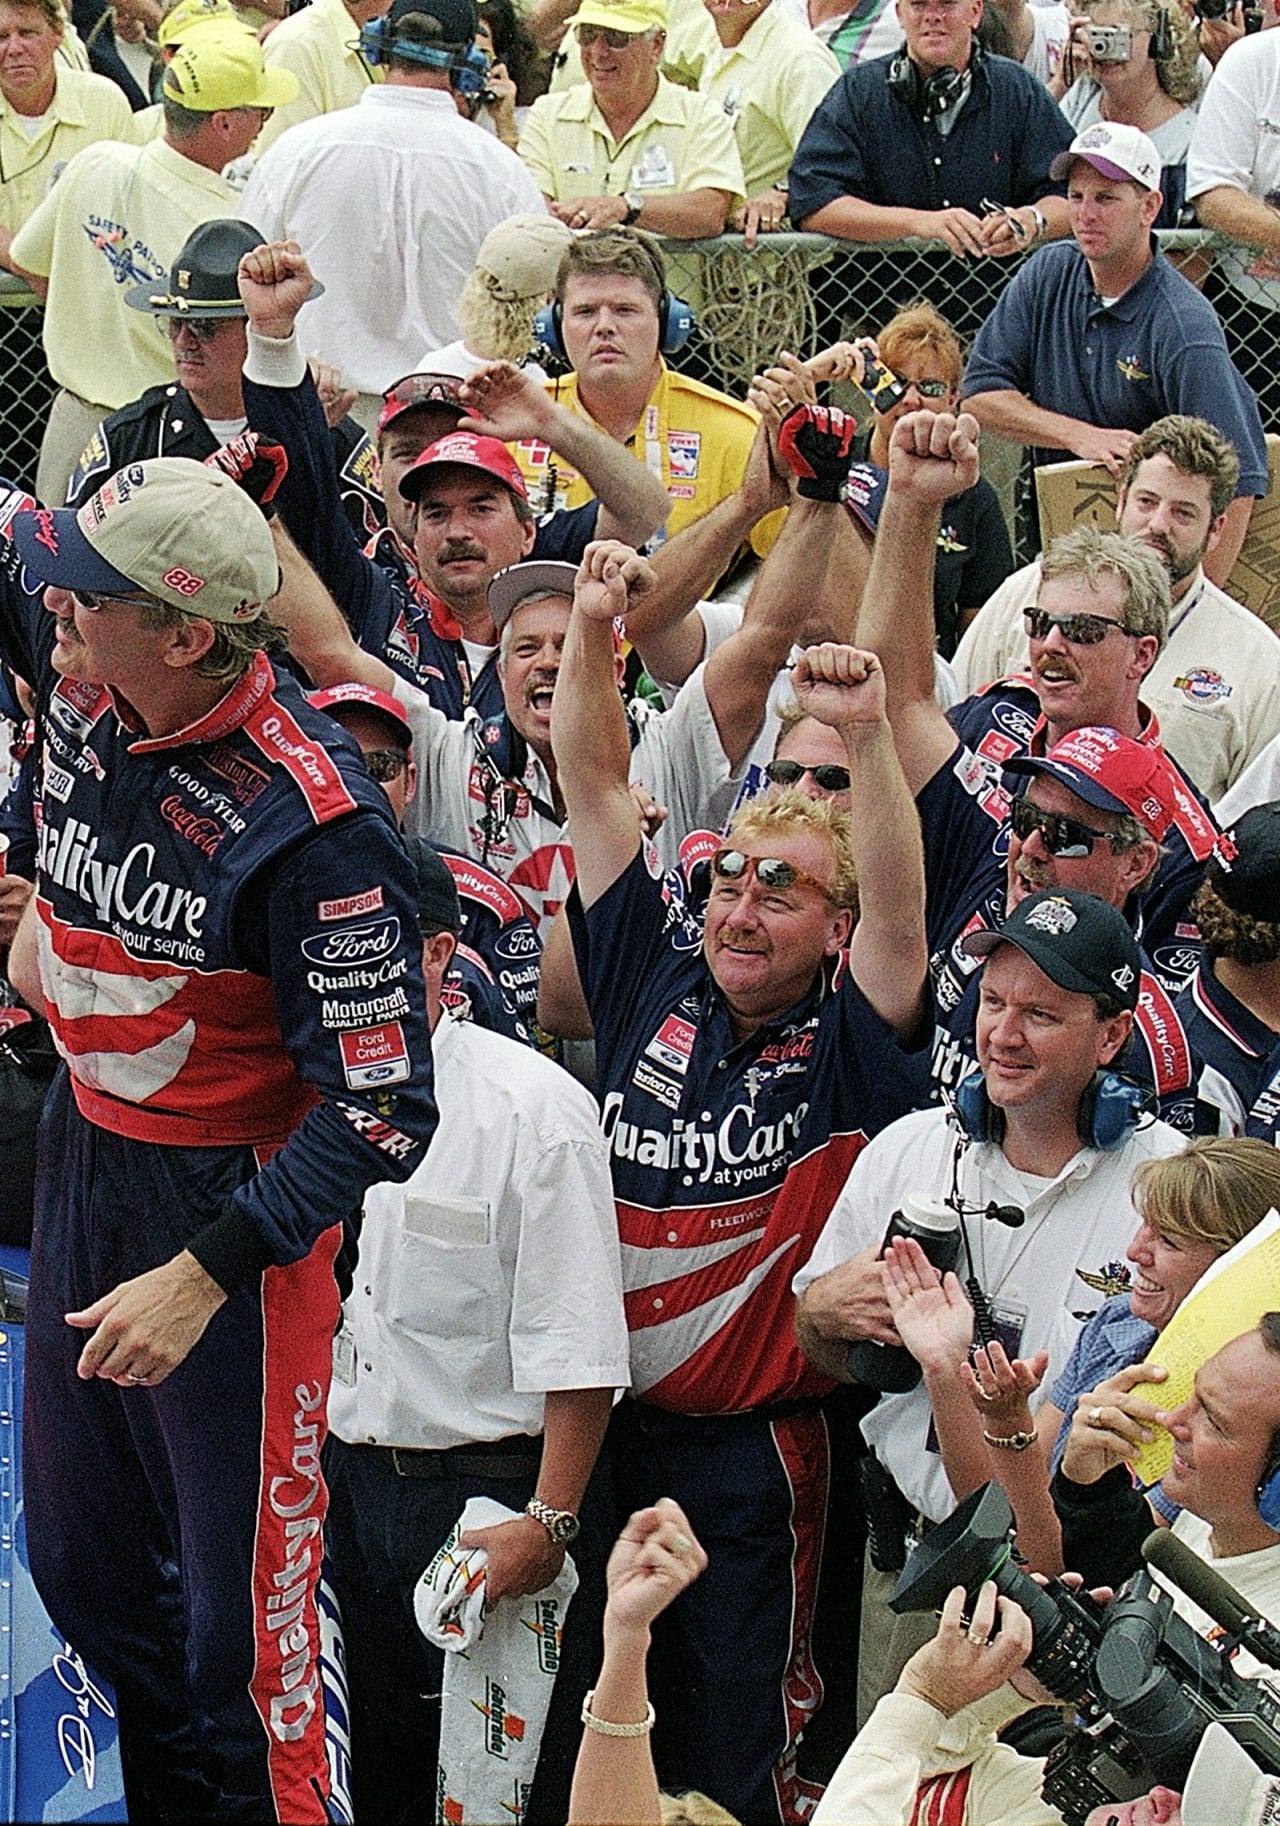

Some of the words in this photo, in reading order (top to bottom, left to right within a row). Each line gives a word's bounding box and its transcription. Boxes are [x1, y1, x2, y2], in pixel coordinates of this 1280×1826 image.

[88, 214, 128, 240] SAFETY
[132, 240, 168, 279] PATRO
[162, 565, 207, 598] 88
[169, 765, 247, 835] GOODYEAR
[1141, 797, 1163, 821] 88
[321, 891, 382, 918] SIMPSON
[450, 873, 510, 911] alityCare
[152, 935, 206, 963] service
[322, 924, 391, 961] Ford
[307, 958, 408, 994] QualityCare
[499, 965, 541, 989] Qualit
[322, 986, 408, 1020] Motorcraft
[322, 1015, 373, 1029] QUALITY
[375, 1003, 411, 1023] PARTS
[358, 1032, 386, 1045] Ford
[674, 1026, 696, 1041] Ford
[355, 1043, 393, 1060] Credit
[713, 1170, 731, 1185] at
[732, 1164, 770, 1187] your
[268, 1379, 323, 1744] QualityCare
[539, 1599, 562, 1672] Gatorade
[490, 1683, 508, 1754] Gatorade
